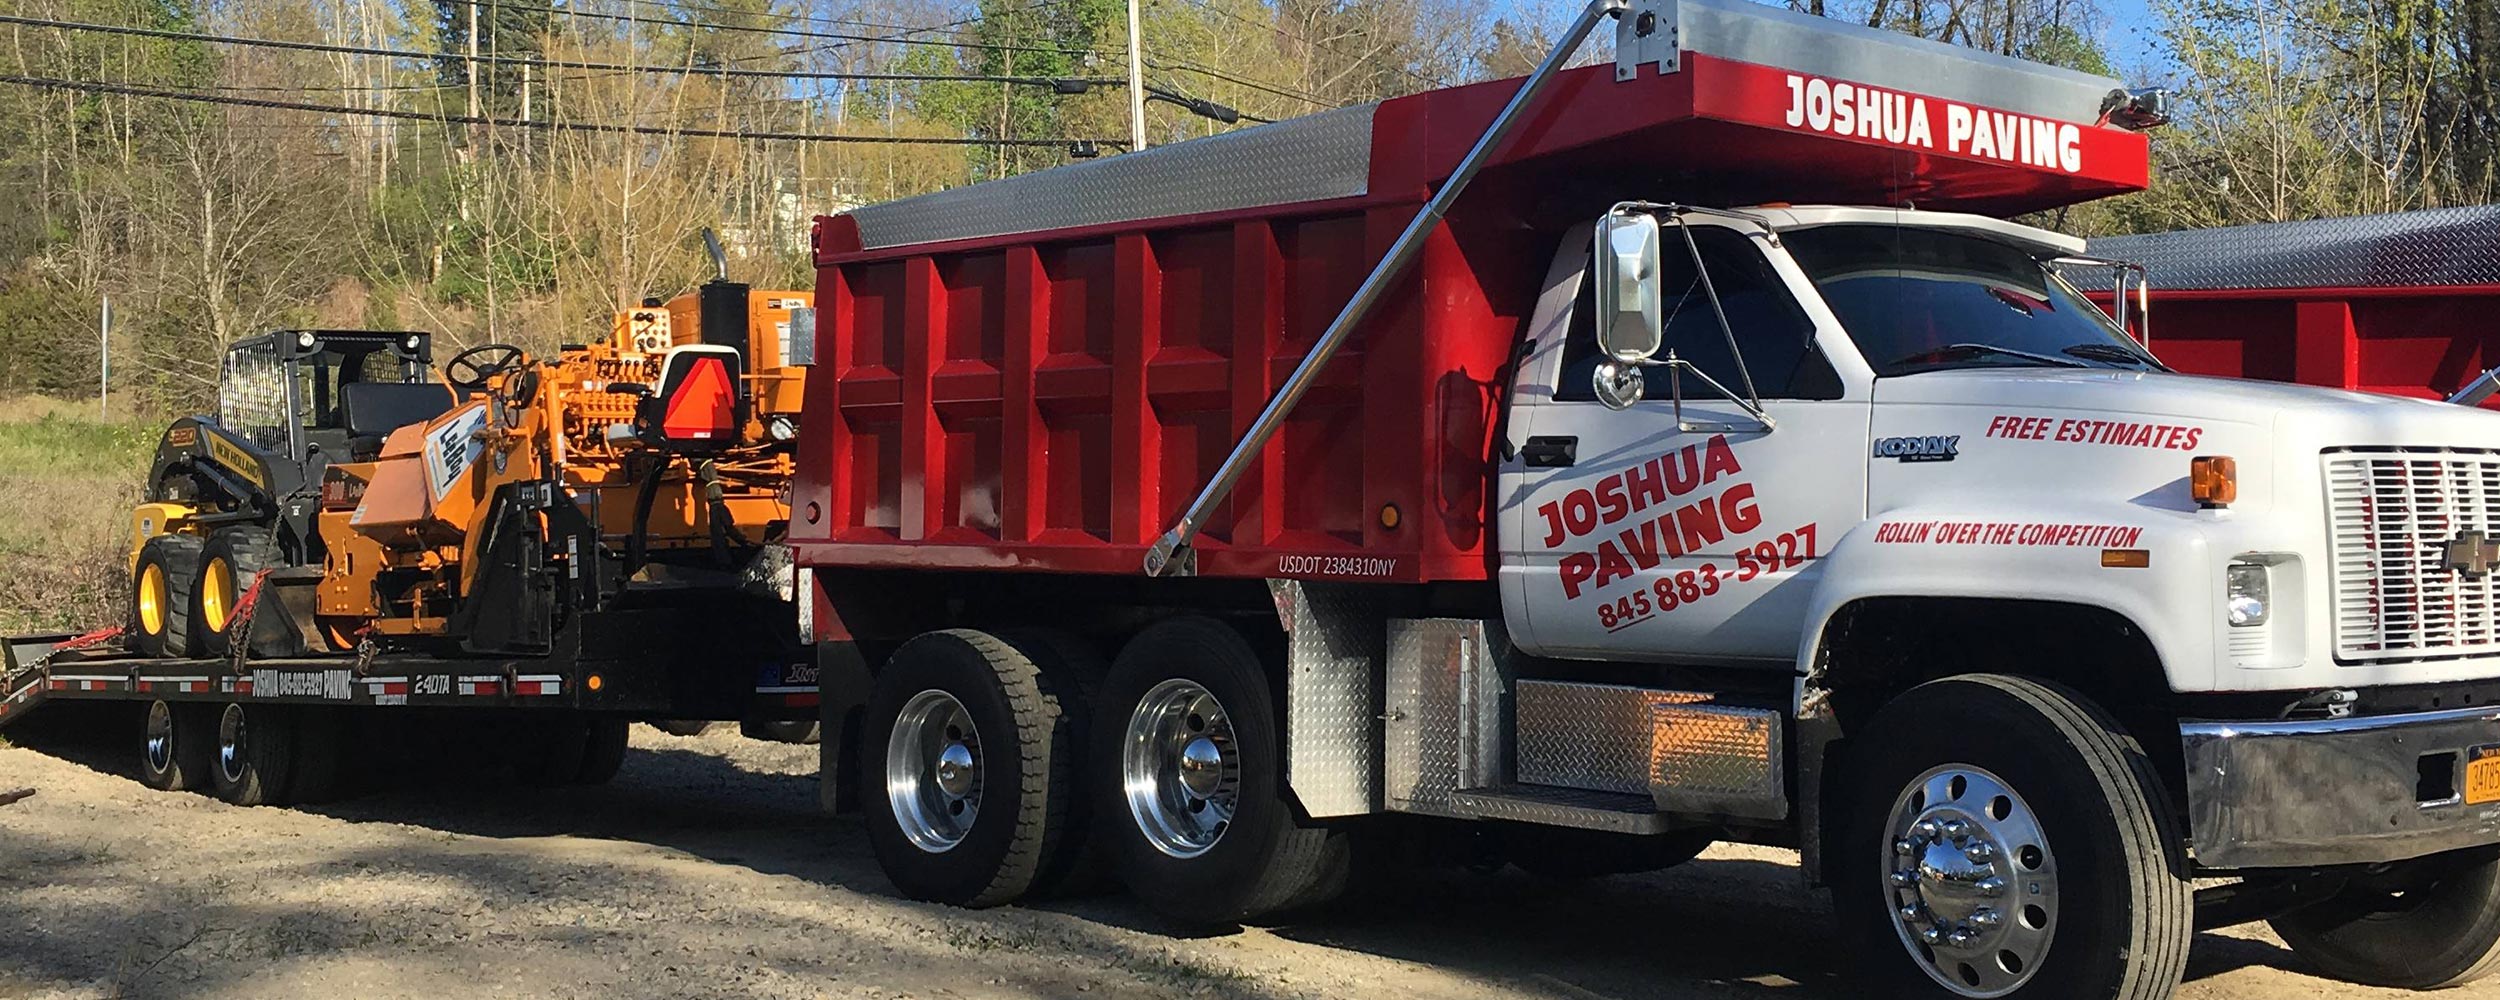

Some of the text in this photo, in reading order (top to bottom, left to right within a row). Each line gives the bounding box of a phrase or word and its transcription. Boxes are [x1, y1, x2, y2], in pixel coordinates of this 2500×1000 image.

[1786, 75, 2081, 173] JOSHUA PAVING
[1874, 436, 1961, 457] KODIAK
[1986, 416, 2203, 451] FREE ESTIMATES
[216, 441, 259, 478] NEW HOLLAND
[440, 419, 467, 488] LeeBoy
[1537, 434, 1742, 548] JOSHUA
[1559, 483, 1762, 600] PAVING
[1874, 521, 2143, 548] ROLLIN' OVER THE COMPETITION
[1279, 555, 1397, 576] USDOT 2384310NY
[1597, 522, 1816, 628] 845 883-5927
[252, 669, 352, 700] JOSHUA 845-883-5927 PAVING
[414, 674, 450, 695] 24DTA
